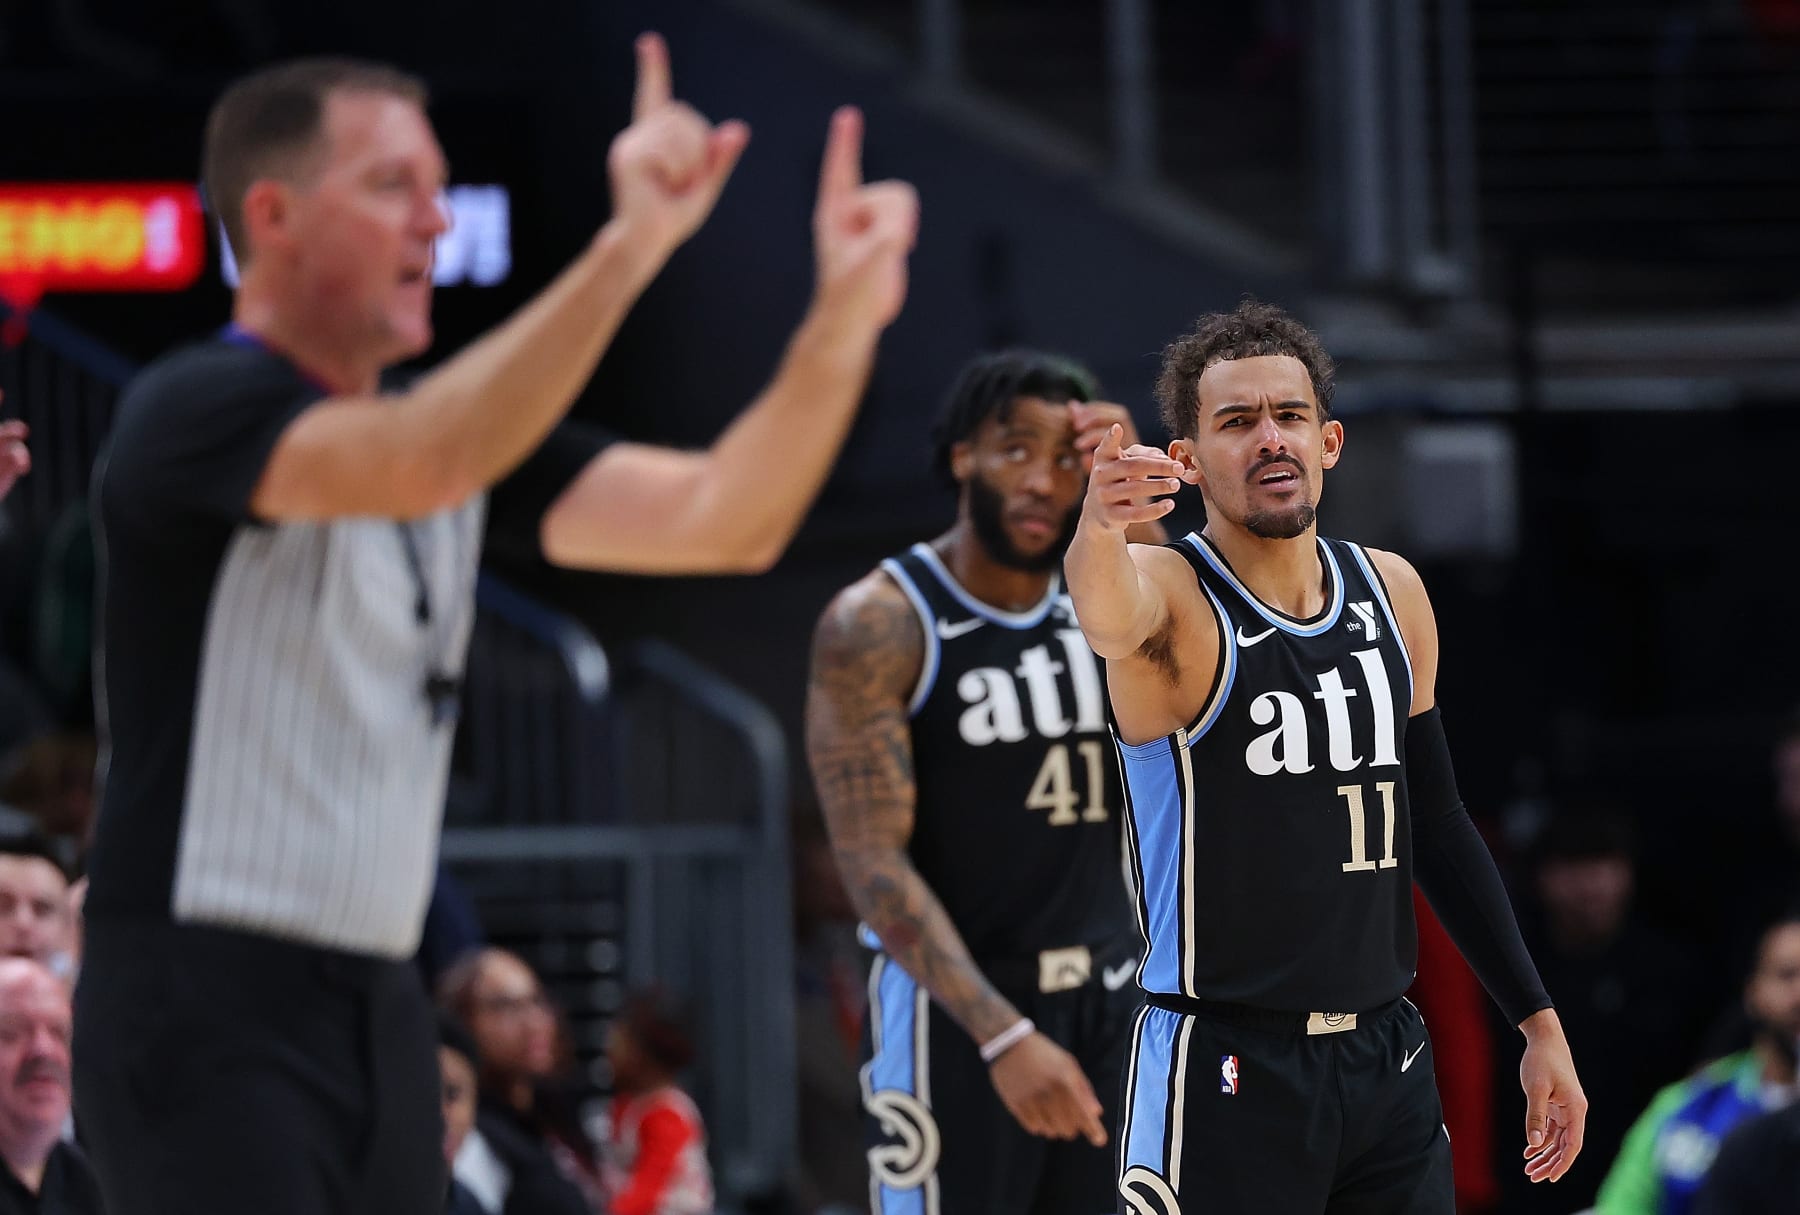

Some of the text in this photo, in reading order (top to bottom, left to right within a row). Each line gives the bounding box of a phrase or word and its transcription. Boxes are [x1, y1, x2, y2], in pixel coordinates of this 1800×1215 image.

[1346, 621, 1362, 632] the
[956, 628, 1108, 746] atl
[1245, 647, 1400, 776] atl
[1025, 741, 1109, 826] 41
[1337, 781, 1398, 873] 11
